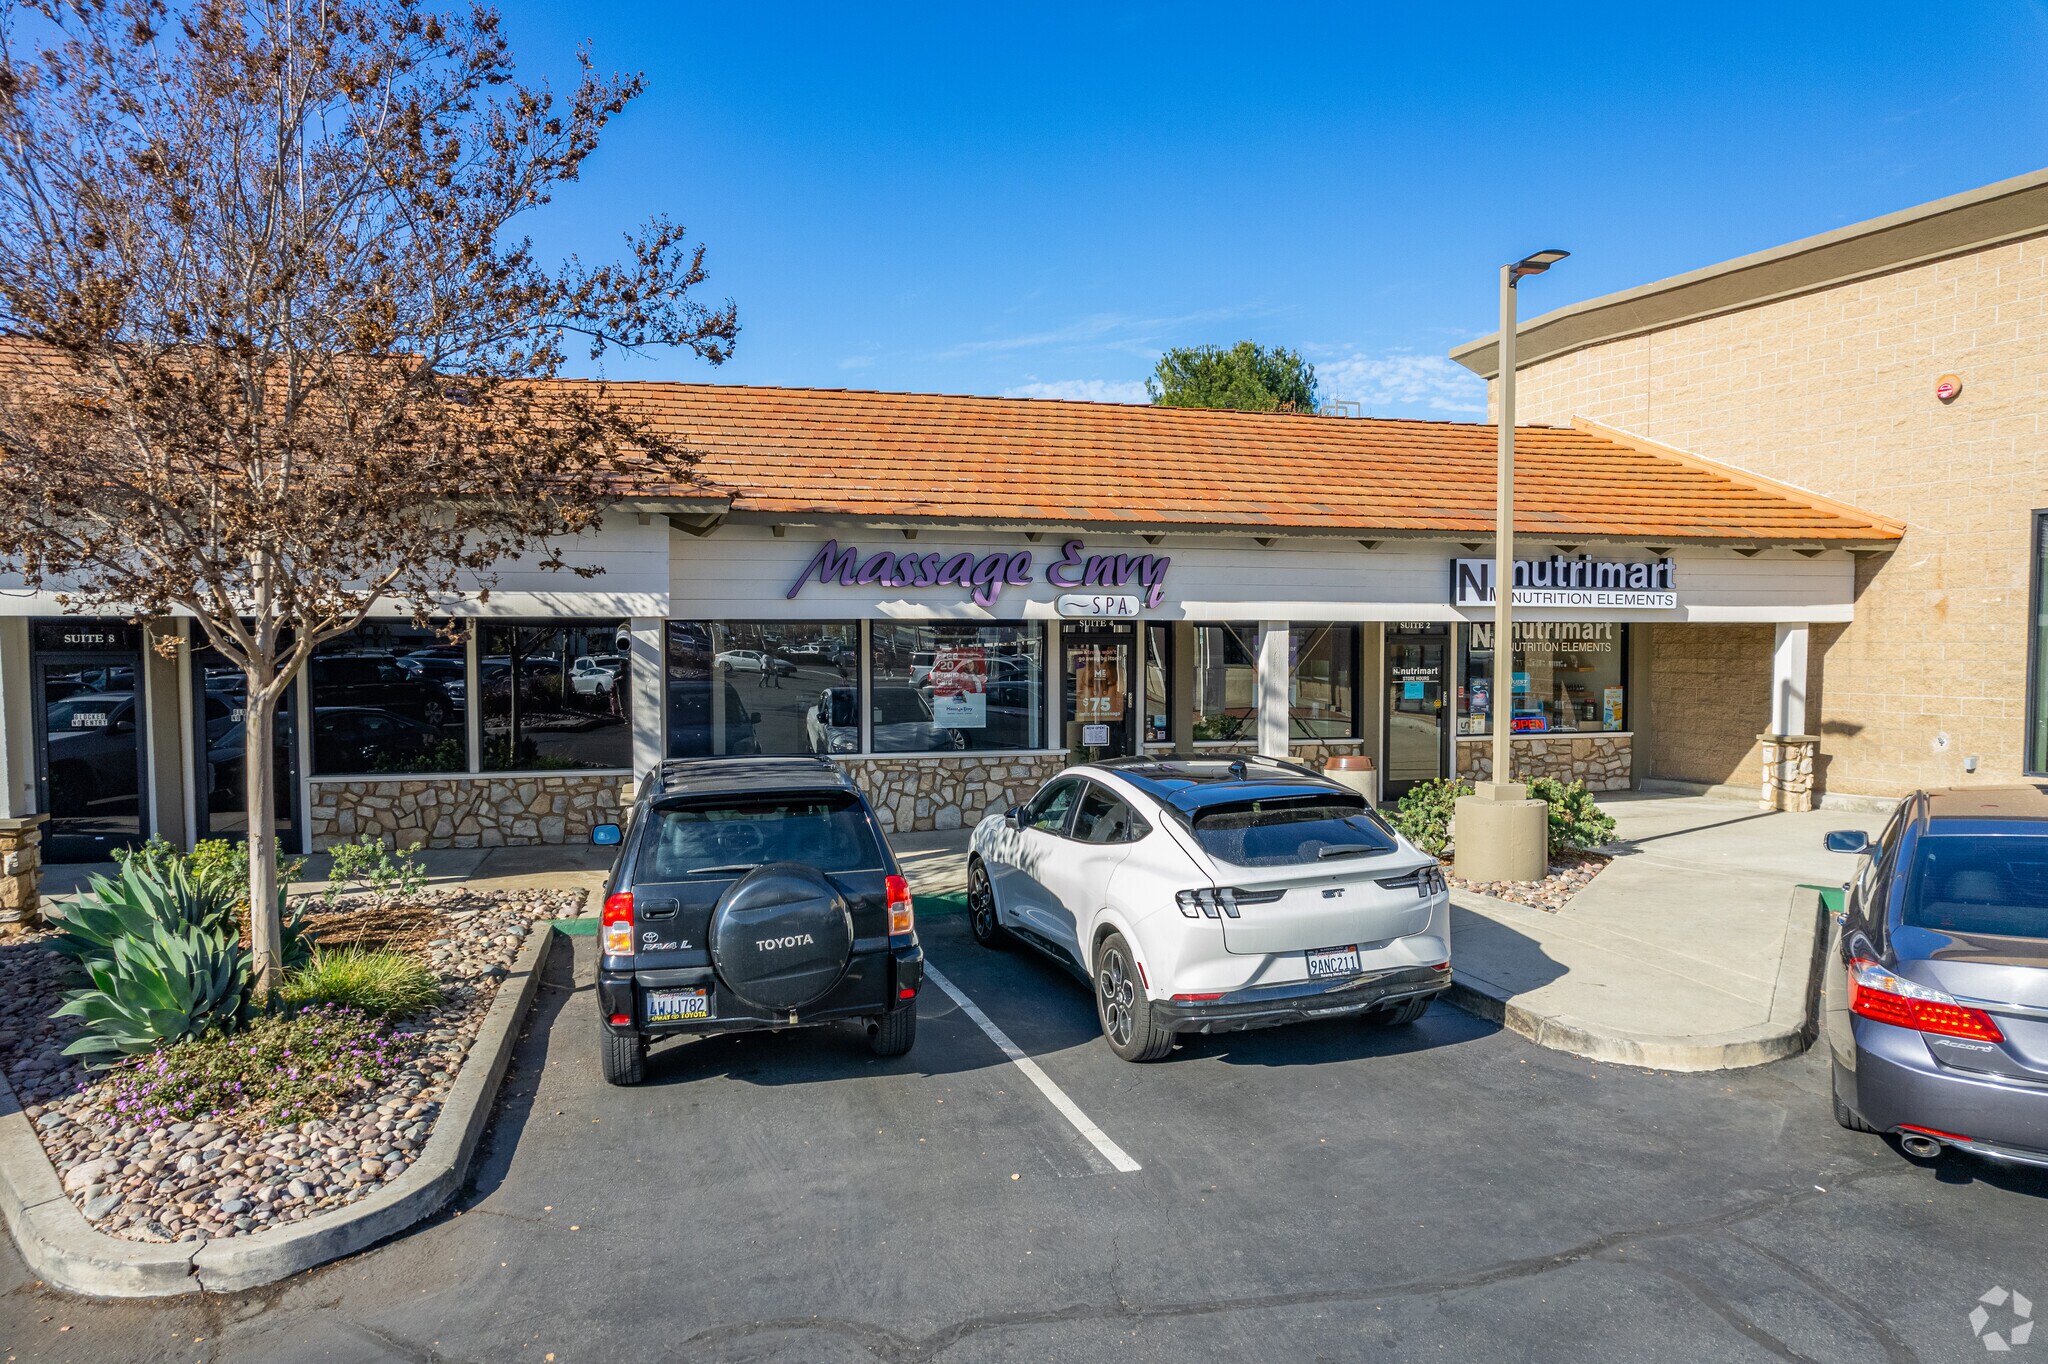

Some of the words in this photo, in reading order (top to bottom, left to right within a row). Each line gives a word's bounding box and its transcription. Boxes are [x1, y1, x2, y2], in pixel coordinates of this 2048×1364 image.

[787, 539, 1033, 607] Massage
[1046, 540, 1170, 609] Envy
[1512, 554, 1676, 589] nutrimart
[1092, 596, 1128, 615] SPA
[1512, 592, 1592, 605] NUTRITION
[1597, 593, 1674, 606] ELEMENTS
[1079, 619, 1107, 627] SUITE
[1108, 619, 1114, 627] 4
[1400, 621, 1424, 629] SUITE
[1512, 621, 1612, 640] nutrimart
[64, 634, 104, 643] SUITE
[108, 634, 115, 643] 8
[1561, 642, 1612, 652] ELEMENTS
[1400, 667, 1439, 675] nutrimart
[1511, 719, 1545, 730] OPEN
[1321, 888, 1345, 899] GT
[756, 933, 814, 951] TOYOTA
[1310, 955, 1357, 974] 9ANC211
[649, 998, 705, 1016] 4WJJ782
[1934, 1040, 1993, 1052] Accord
